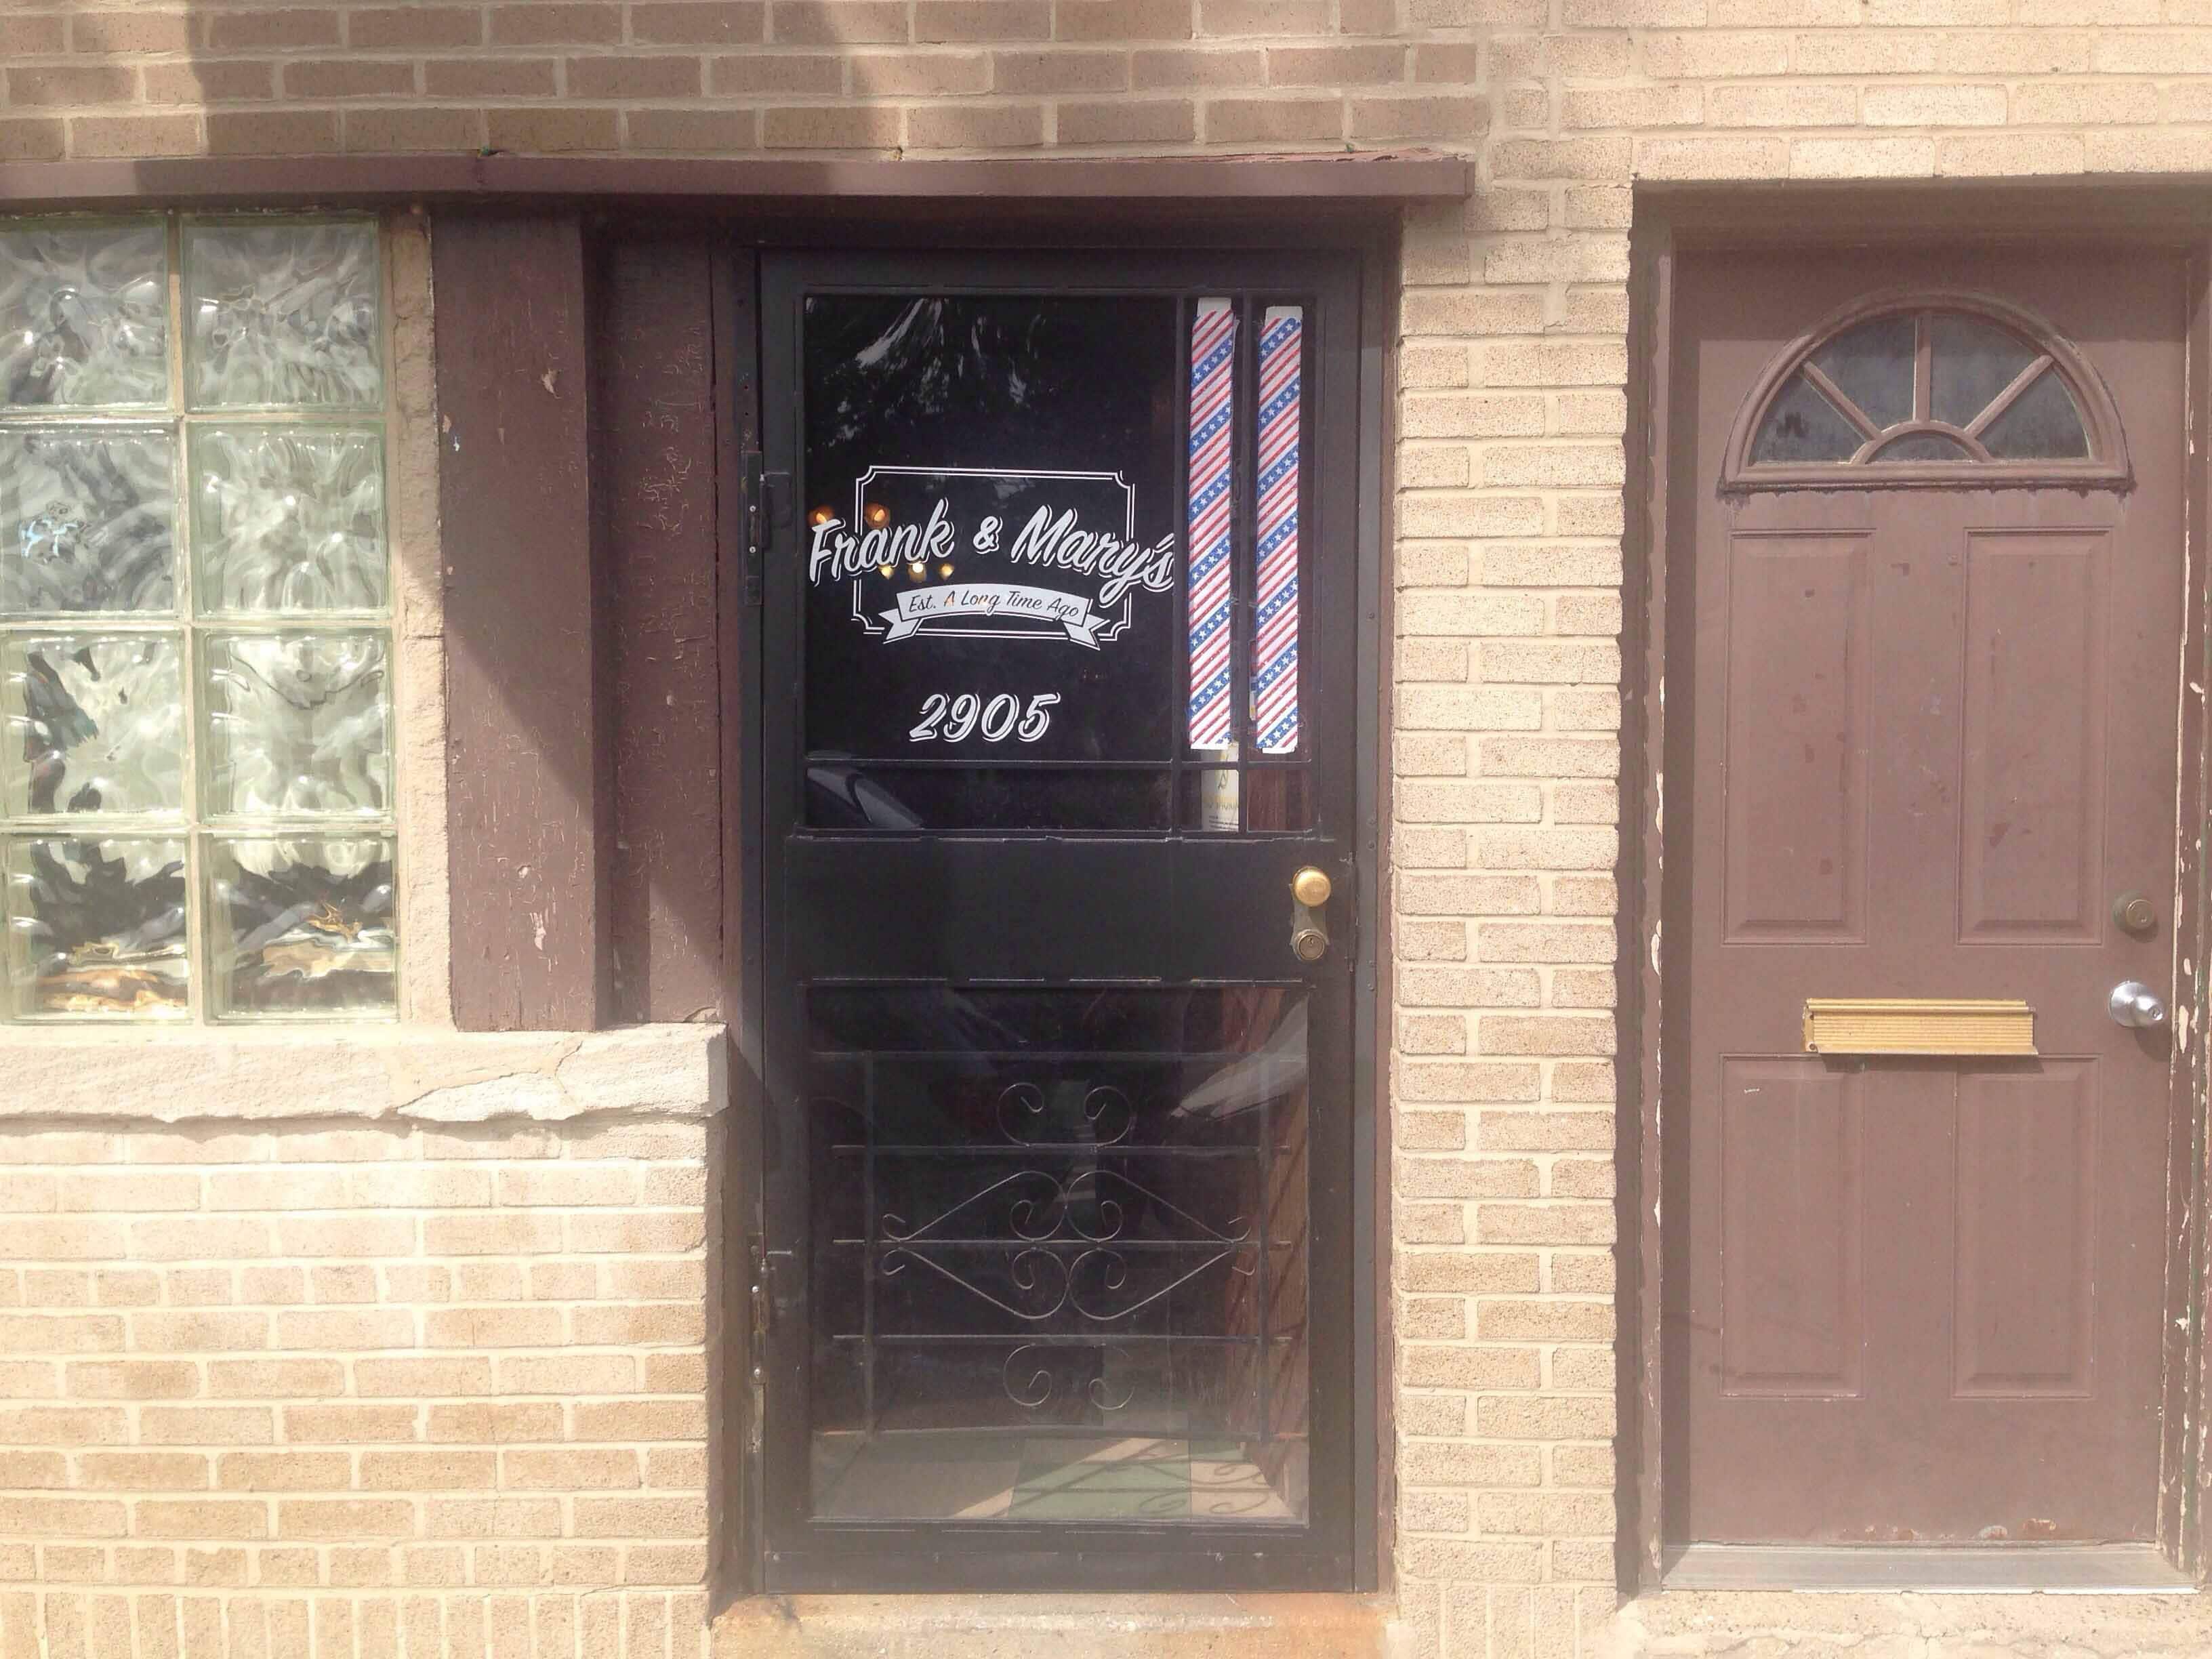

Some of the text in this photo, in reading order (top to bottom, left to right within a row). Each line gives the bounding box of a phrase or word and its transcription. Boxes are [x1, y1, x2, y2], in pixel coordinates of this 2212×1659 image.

[808, 497, 1174, 609] Frank & Mary's
[908, 589, 1080, 621] Est. A Long Time Ago
[908, 692, 1061, 743] 2905
